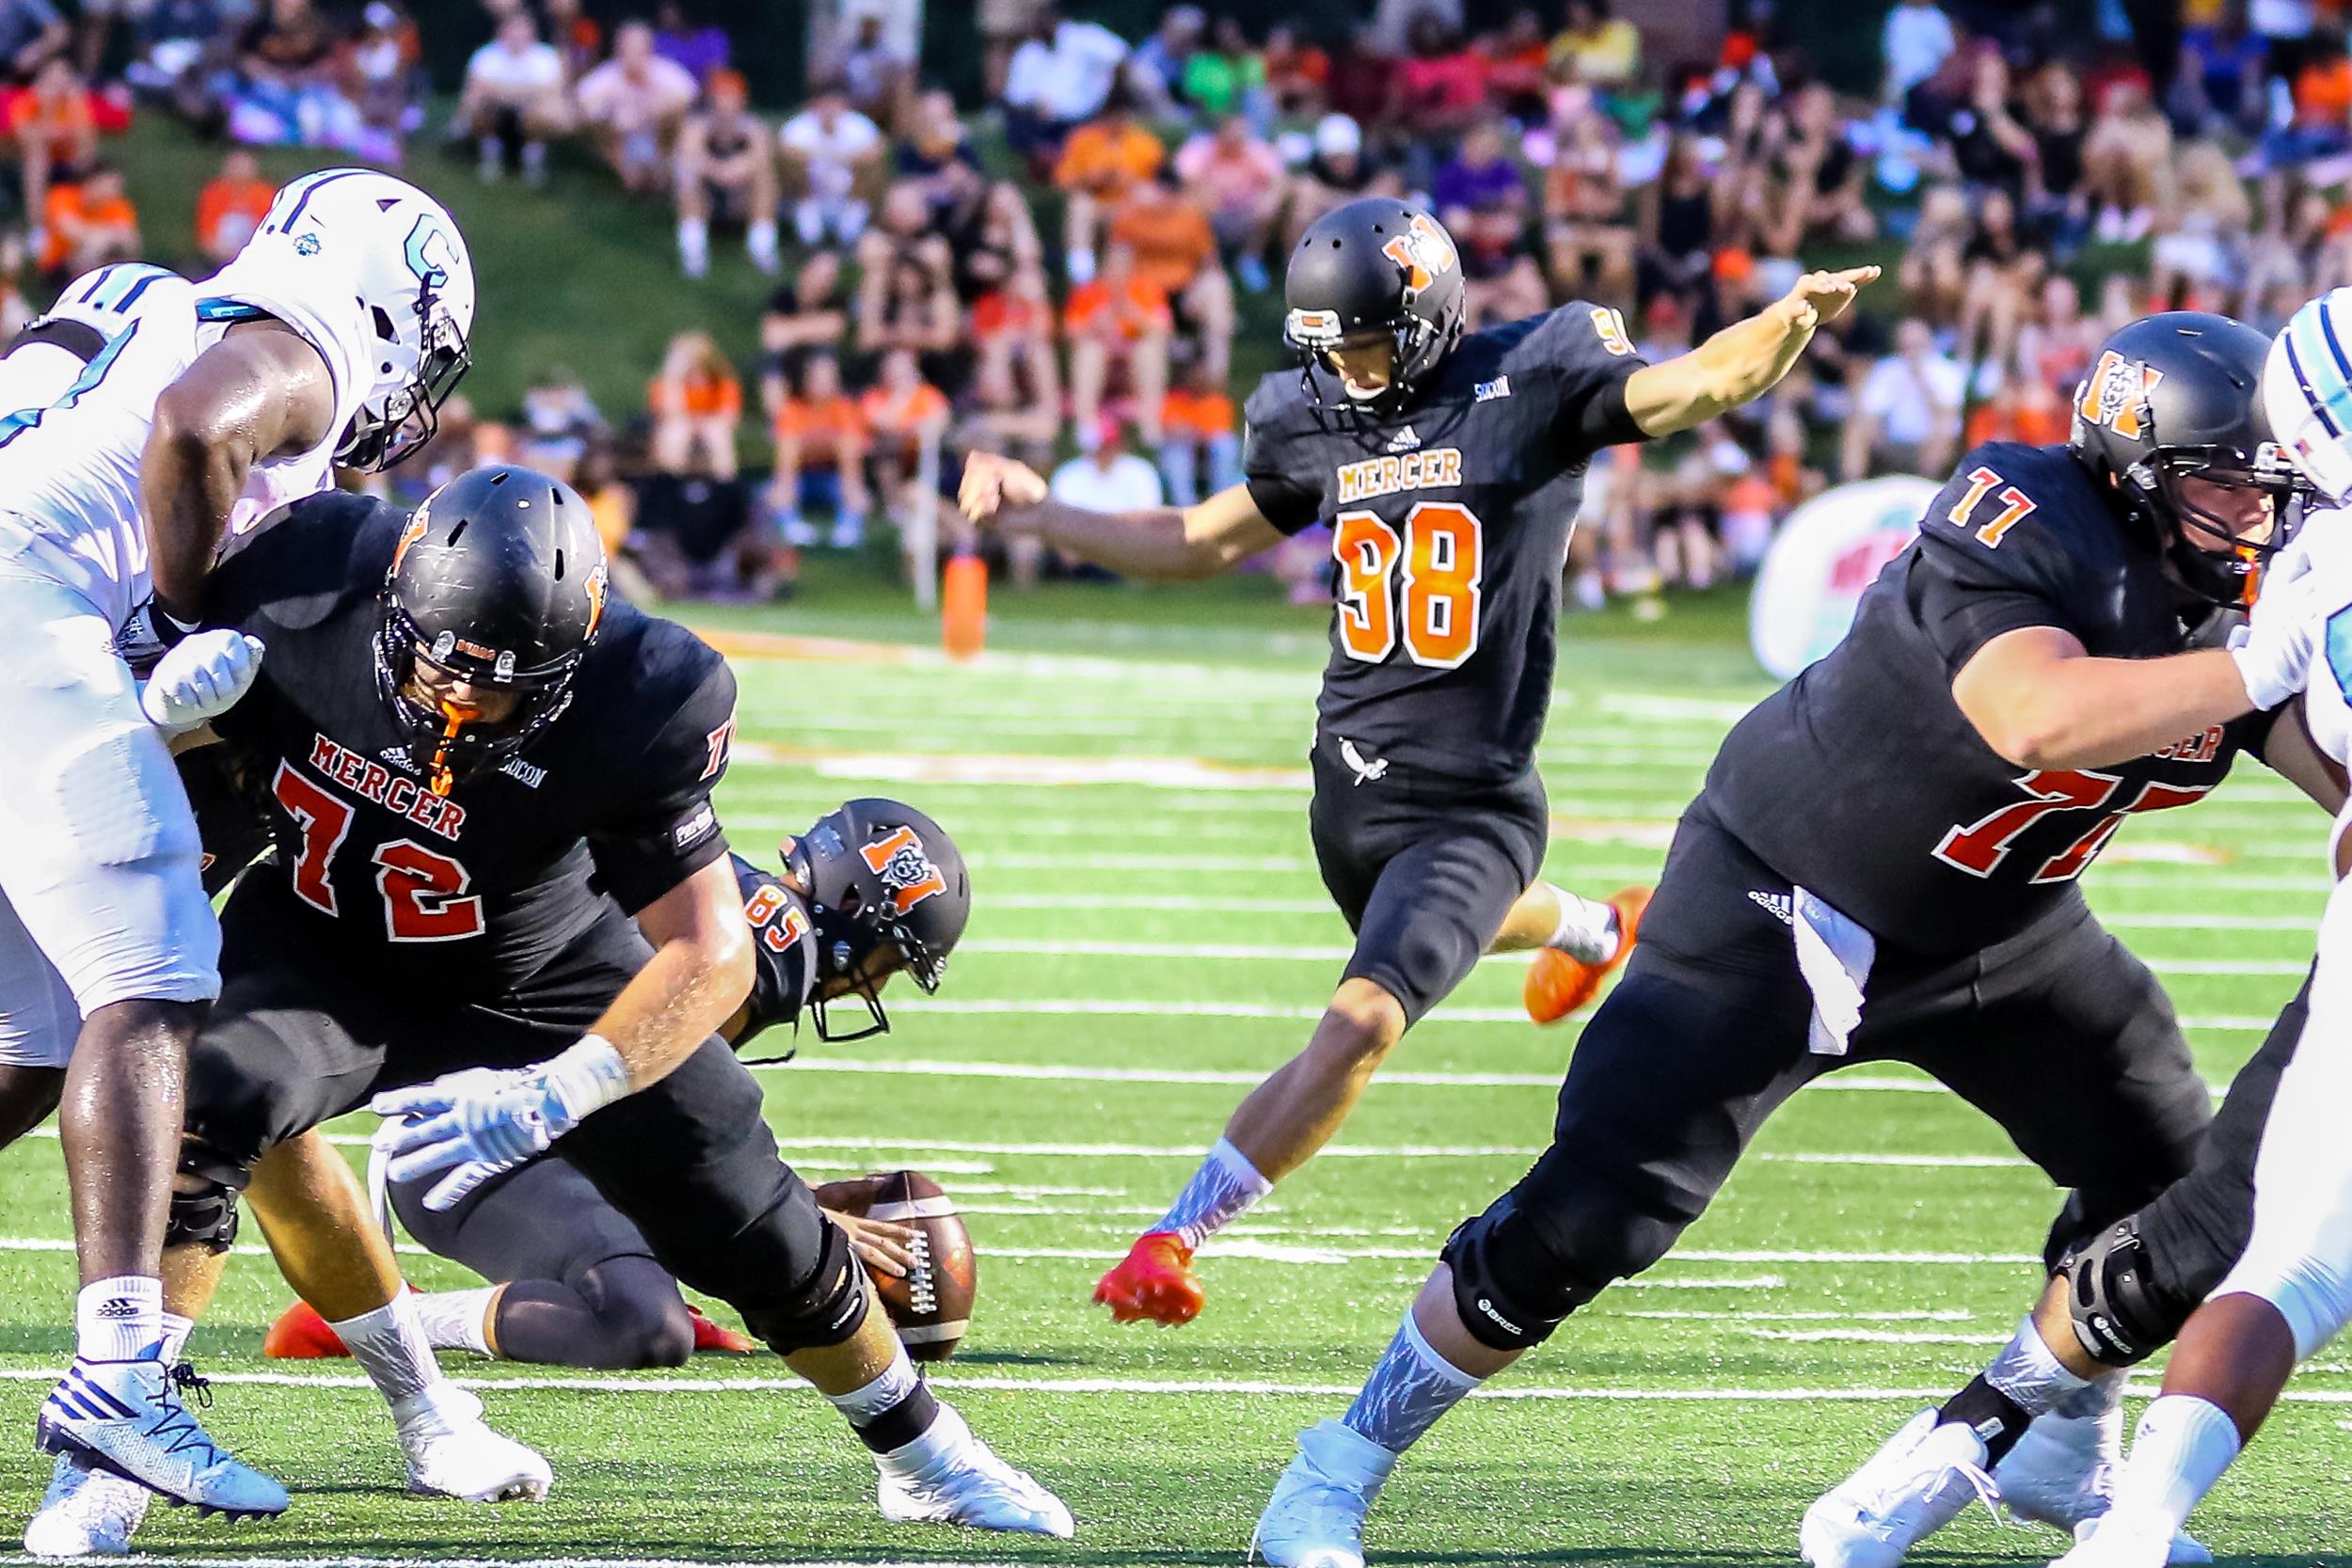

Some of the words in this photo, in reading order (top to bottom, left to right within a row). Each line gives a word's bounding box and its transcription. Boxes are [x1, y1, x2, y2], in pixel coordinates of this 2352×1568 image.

[1338, 447, 1462, 504] MERCER
[1947, 467, 2037, 549] 77
[1334, 501, 1484, 670] 98
[309, 732, 468, 842] MERCER
[272, 755, 485, 943] 72
[745, 883, 811, 953] 85
